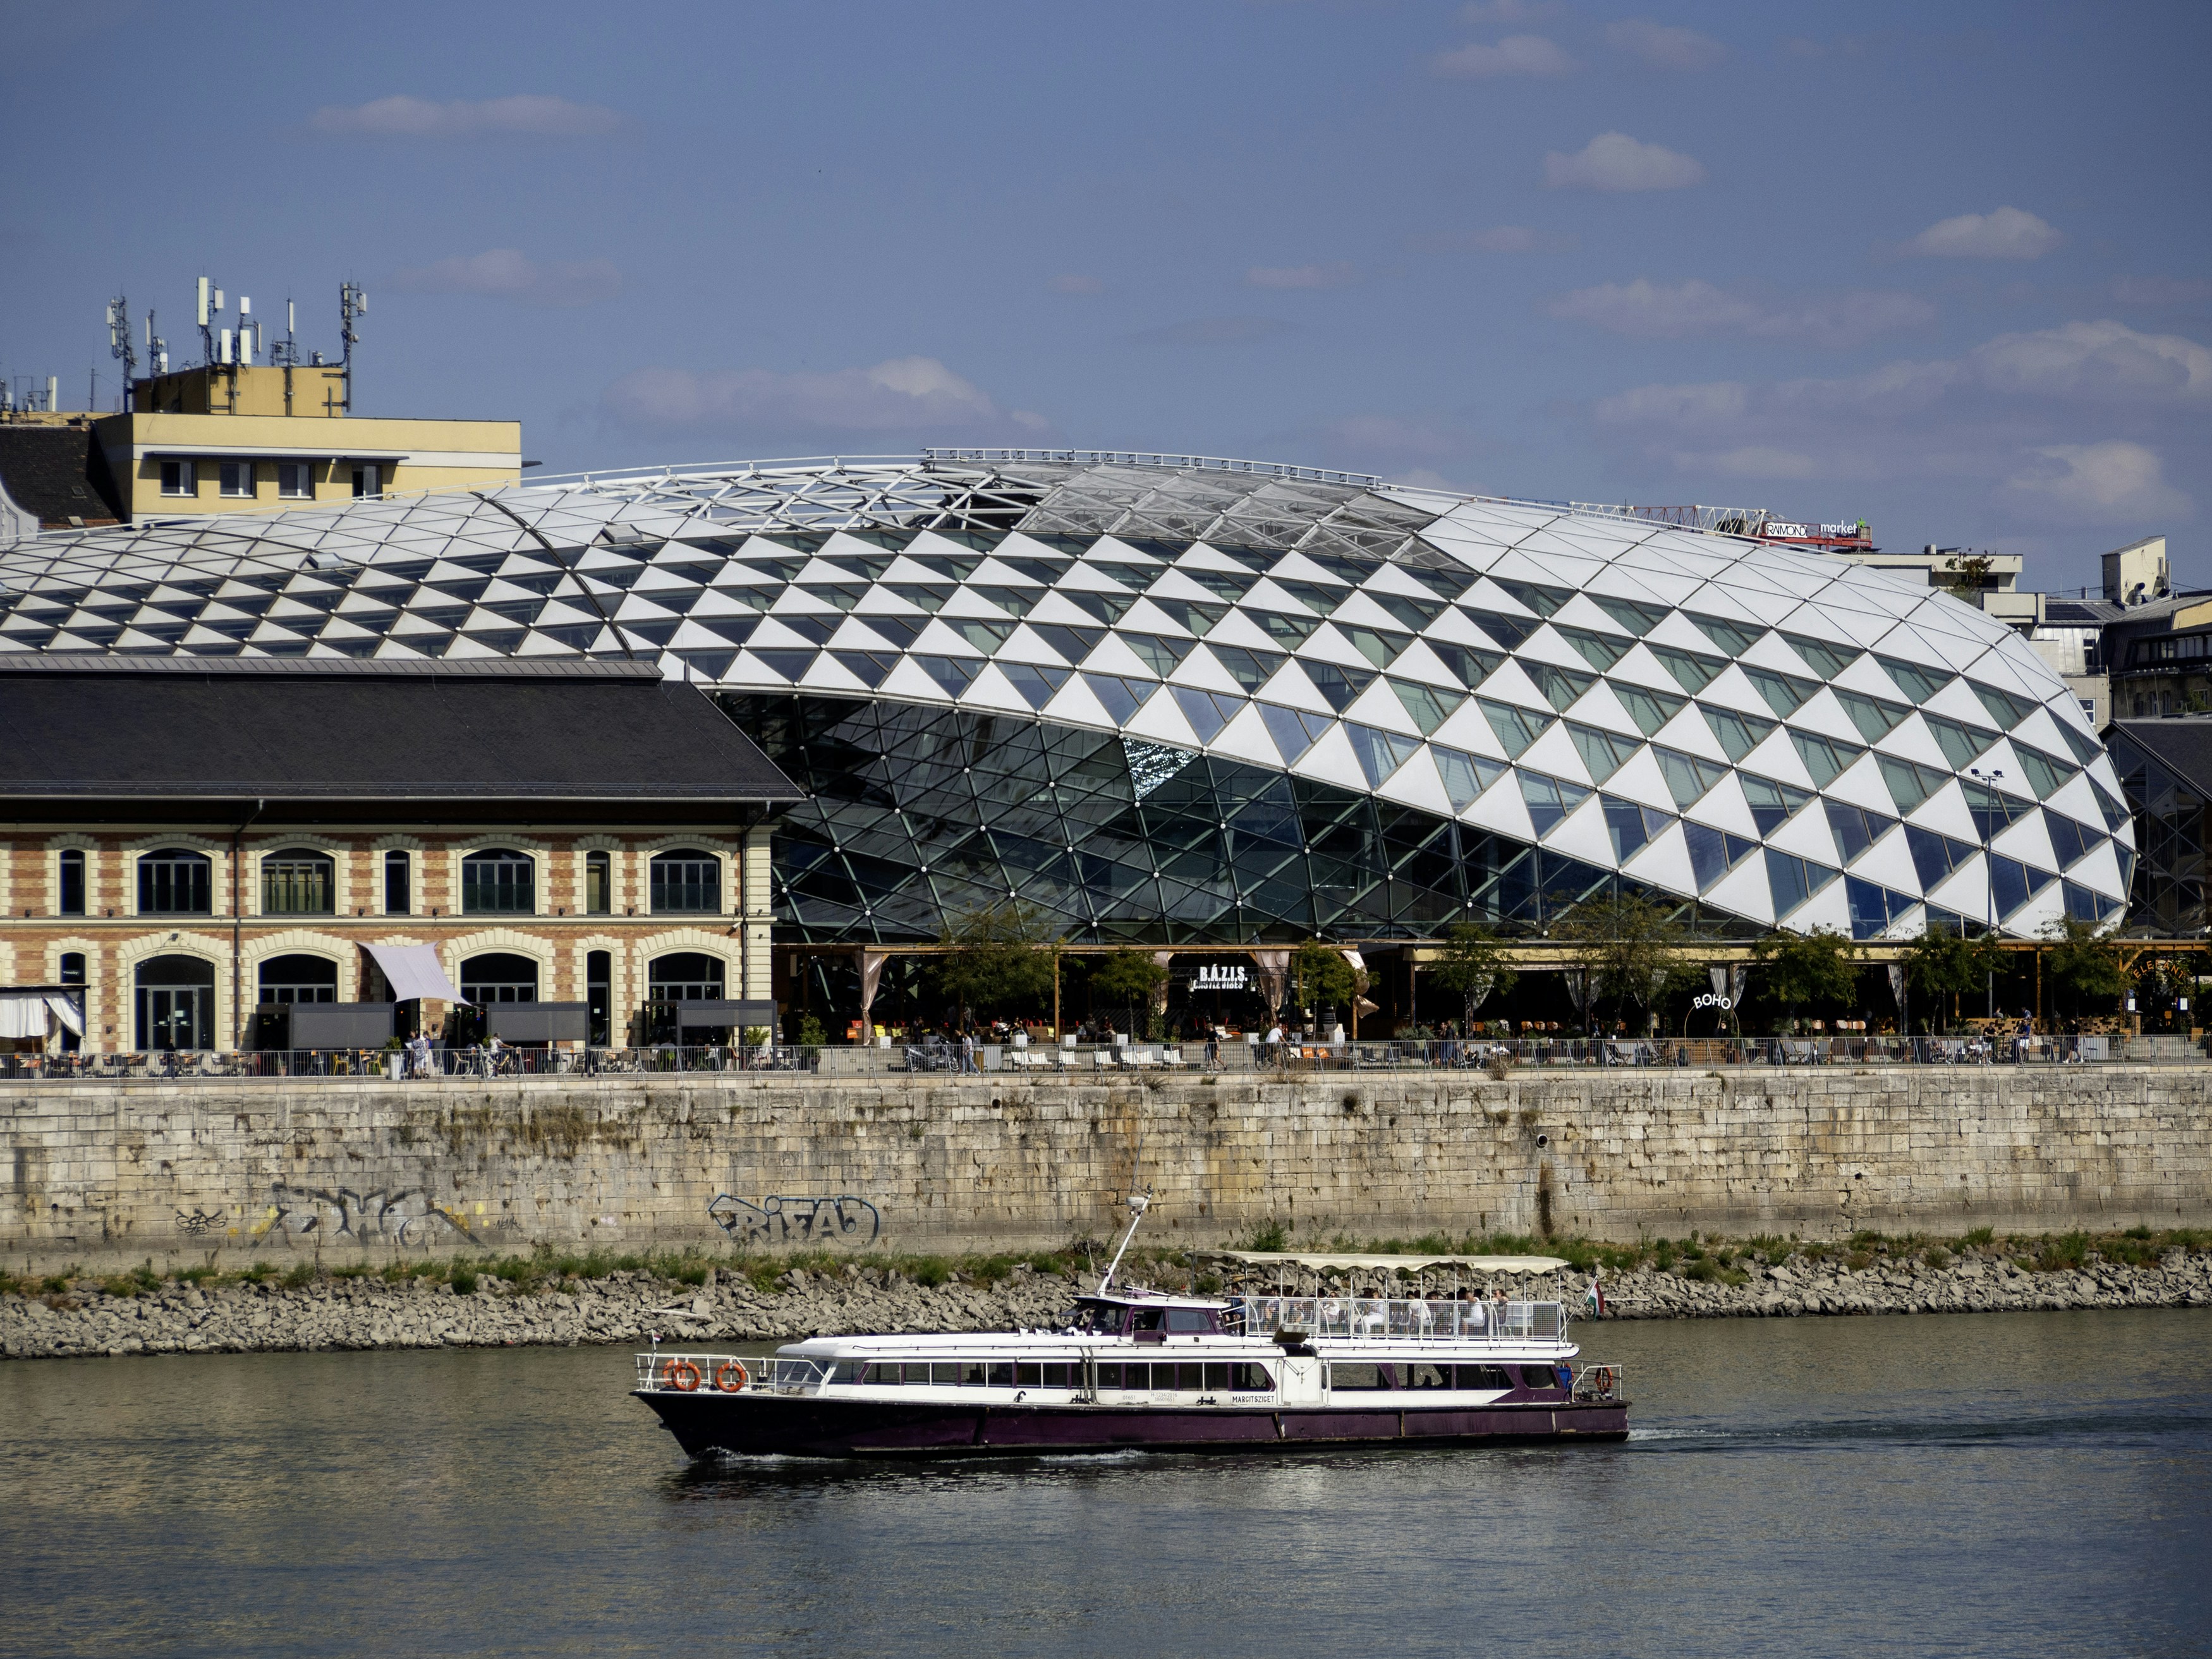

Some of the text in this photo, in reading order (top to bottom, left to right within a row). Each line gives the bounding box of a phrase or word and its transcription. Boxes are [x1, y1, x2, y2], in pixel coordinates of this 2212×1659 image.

[1820, 520, 1857, 534] market
[1200, 964, 1248, 981] B.Á.Z.I.S.
[1693, 994, 1732, 1010] BOHO
